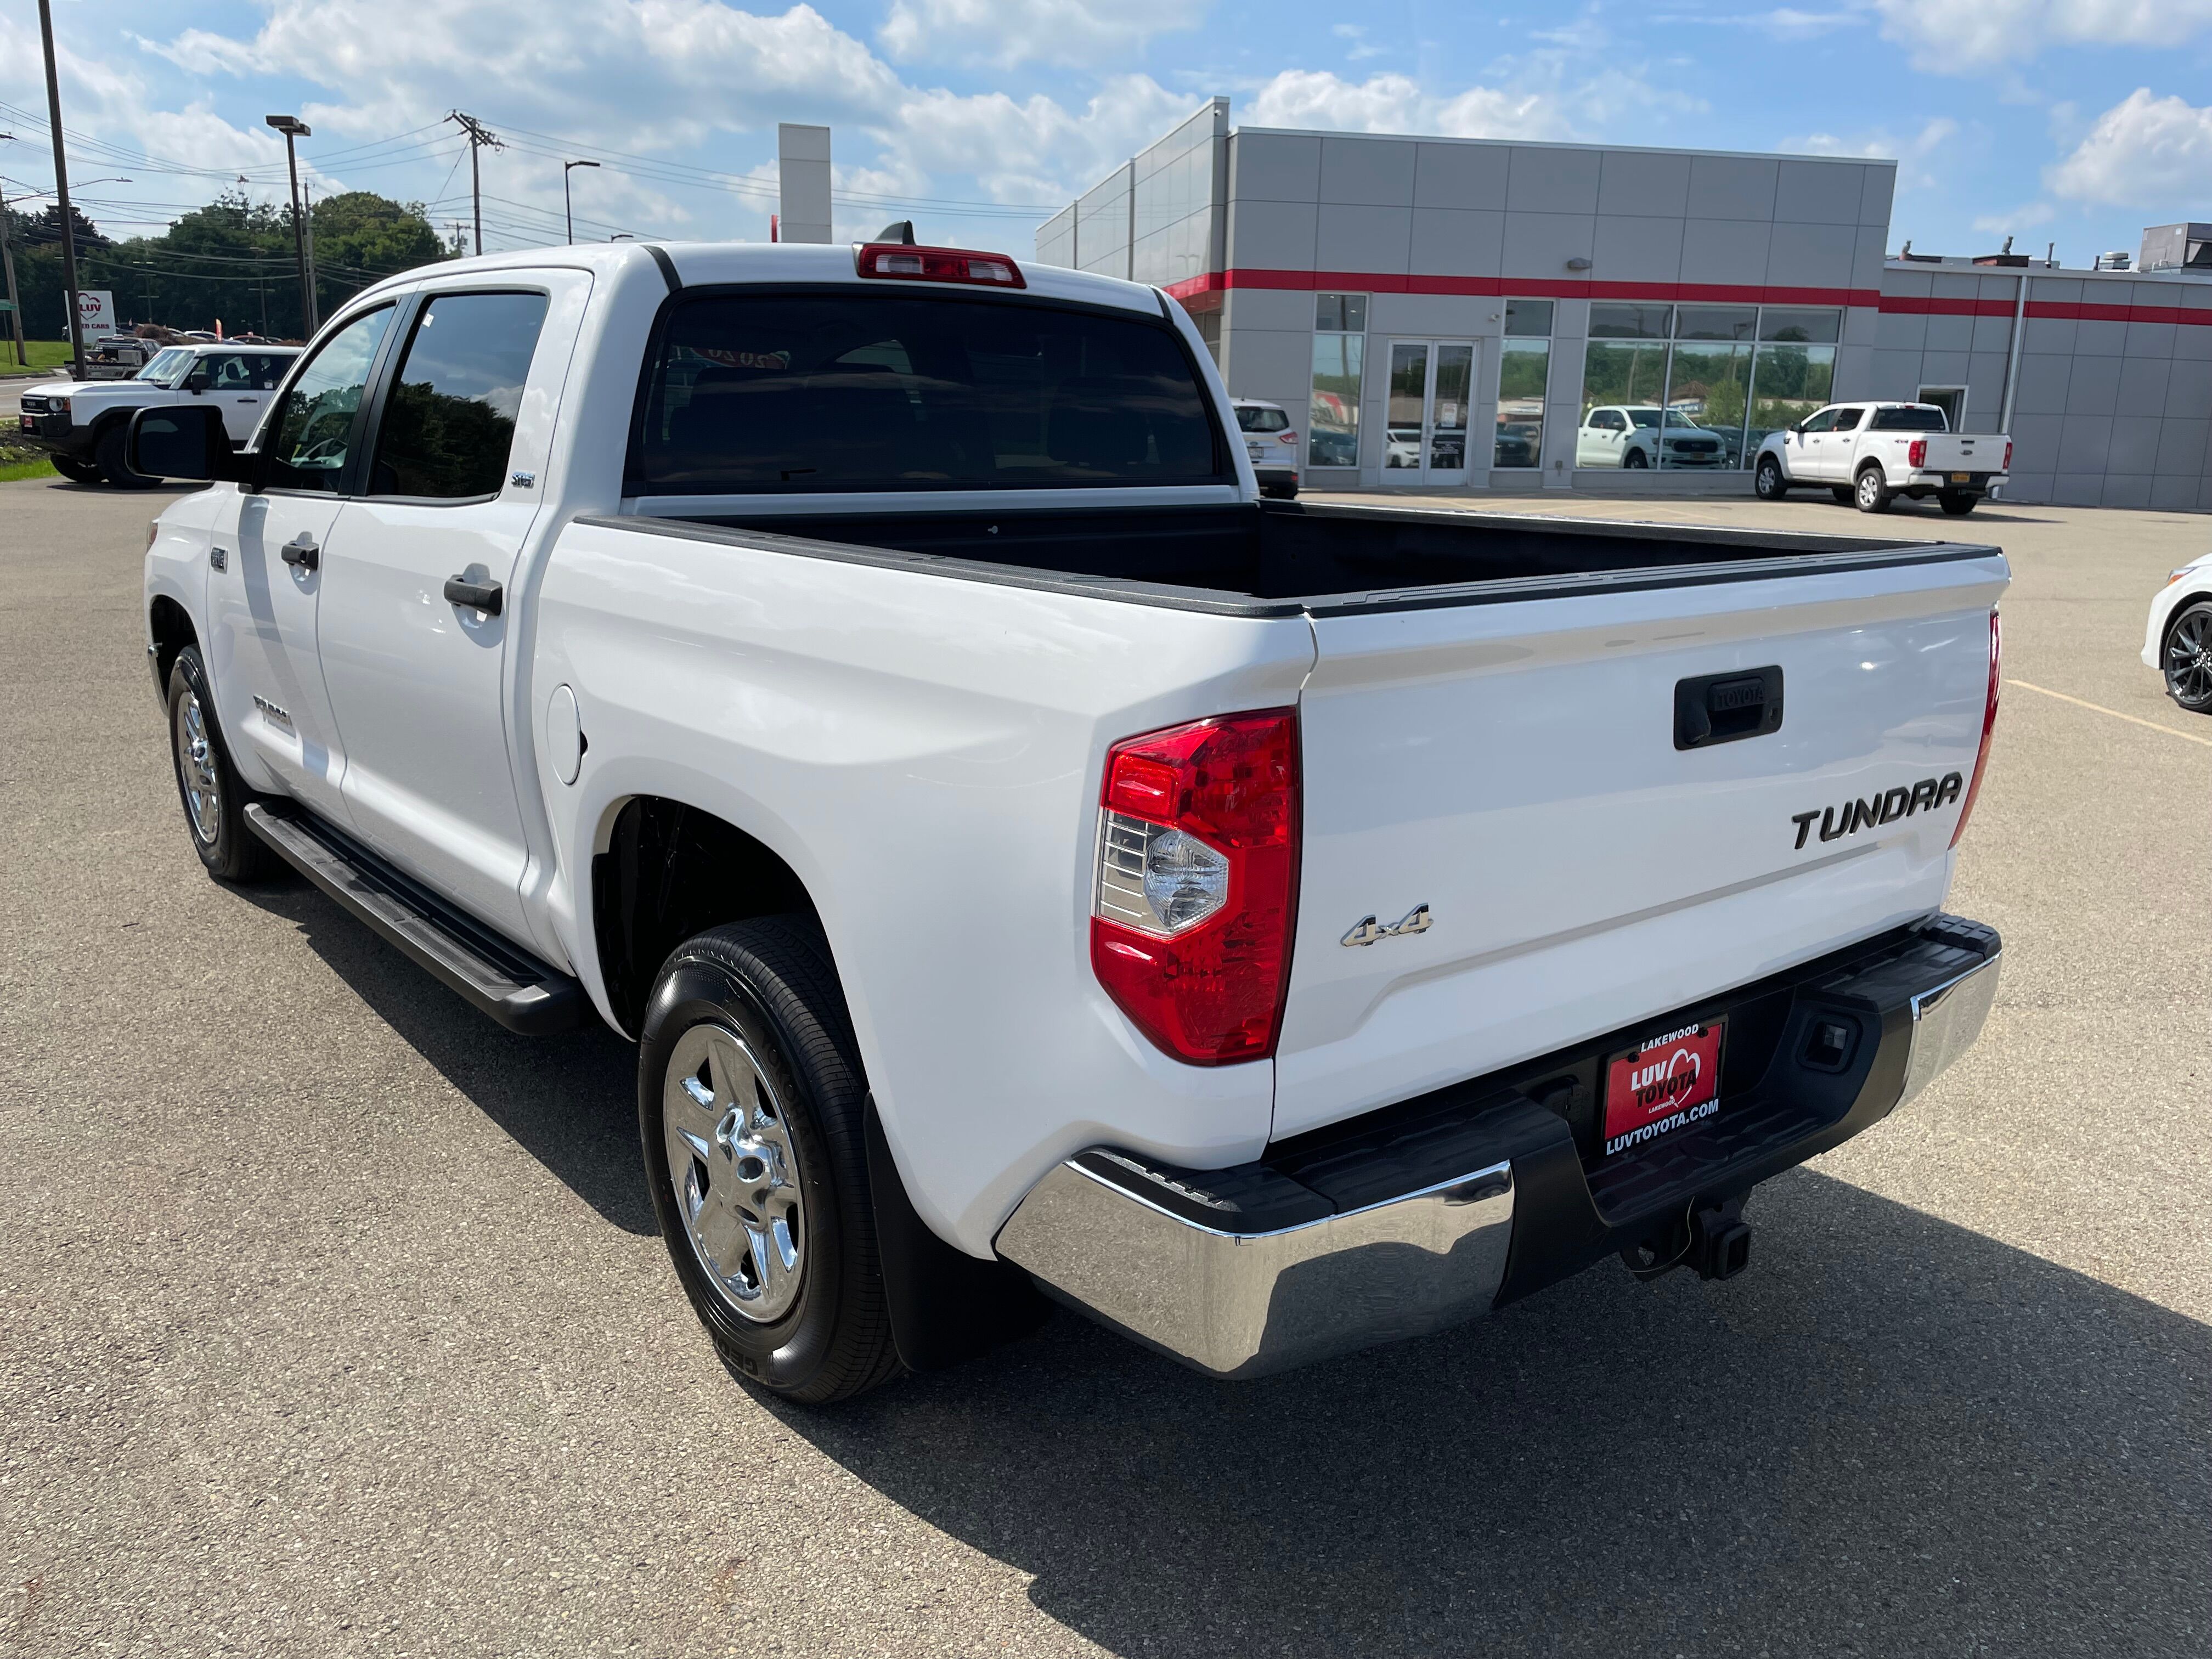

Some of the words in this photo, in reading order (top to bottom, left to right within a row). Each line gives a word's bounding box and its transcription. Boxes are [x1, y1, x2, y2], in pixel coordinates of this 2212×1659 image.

[1719, 686, 1765, 707] TOYOTA
[1792, 771, 1962, 850] TUNDRA
[1640, 1023, 1699, 1053] LAKEWOOD
[1631, 1060, 1667, 1091] LUV
[1636, 1069, 1697, 1108] TOYOTA
[1649, 1099, 1675, 1114] LAKEWOOD
[1606, 1098, 1719, 1155] LUVTOYOTA.COM
